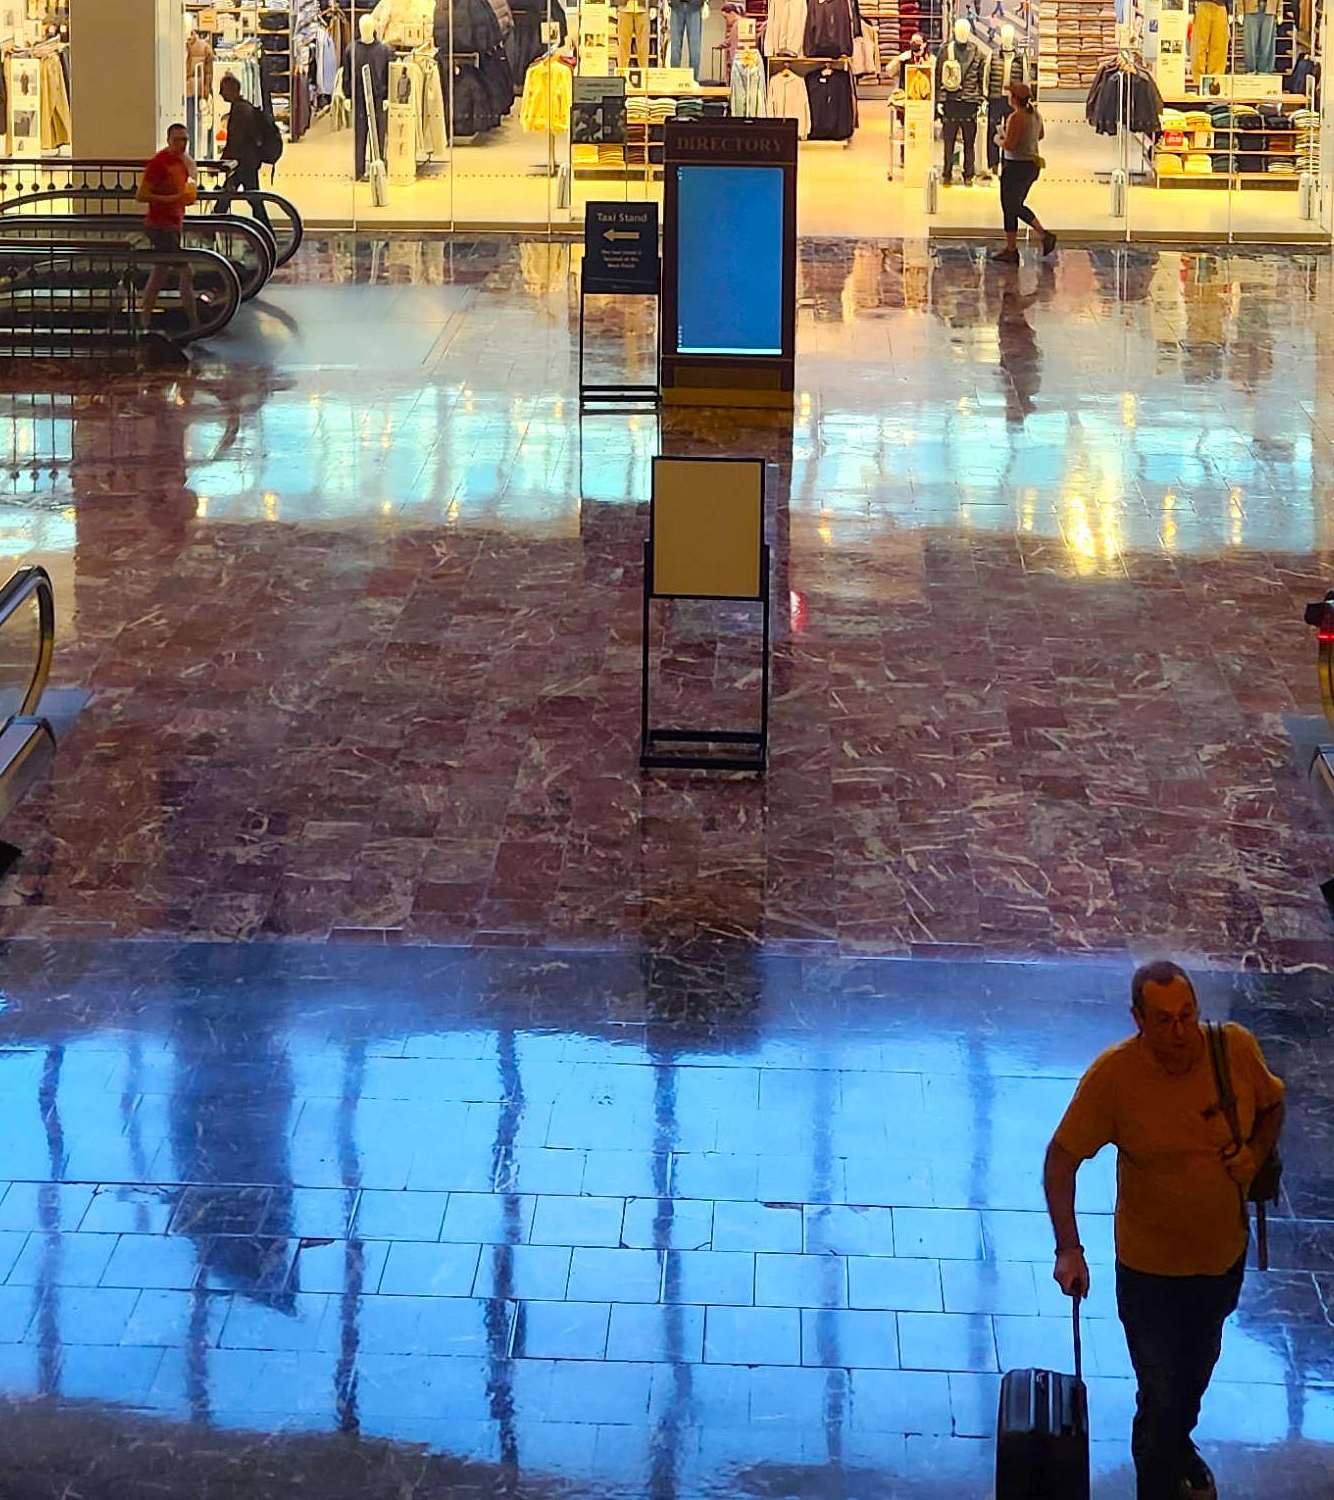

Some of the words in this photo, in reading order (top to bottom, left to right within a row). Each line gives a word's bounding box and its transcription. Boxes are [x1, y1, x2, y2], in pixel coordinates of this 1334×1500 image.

[677, 136, 785, 152] DIRECTORY
[597, 213, 616, 222] Taxi
[619, 213, 648, 222] Stand
